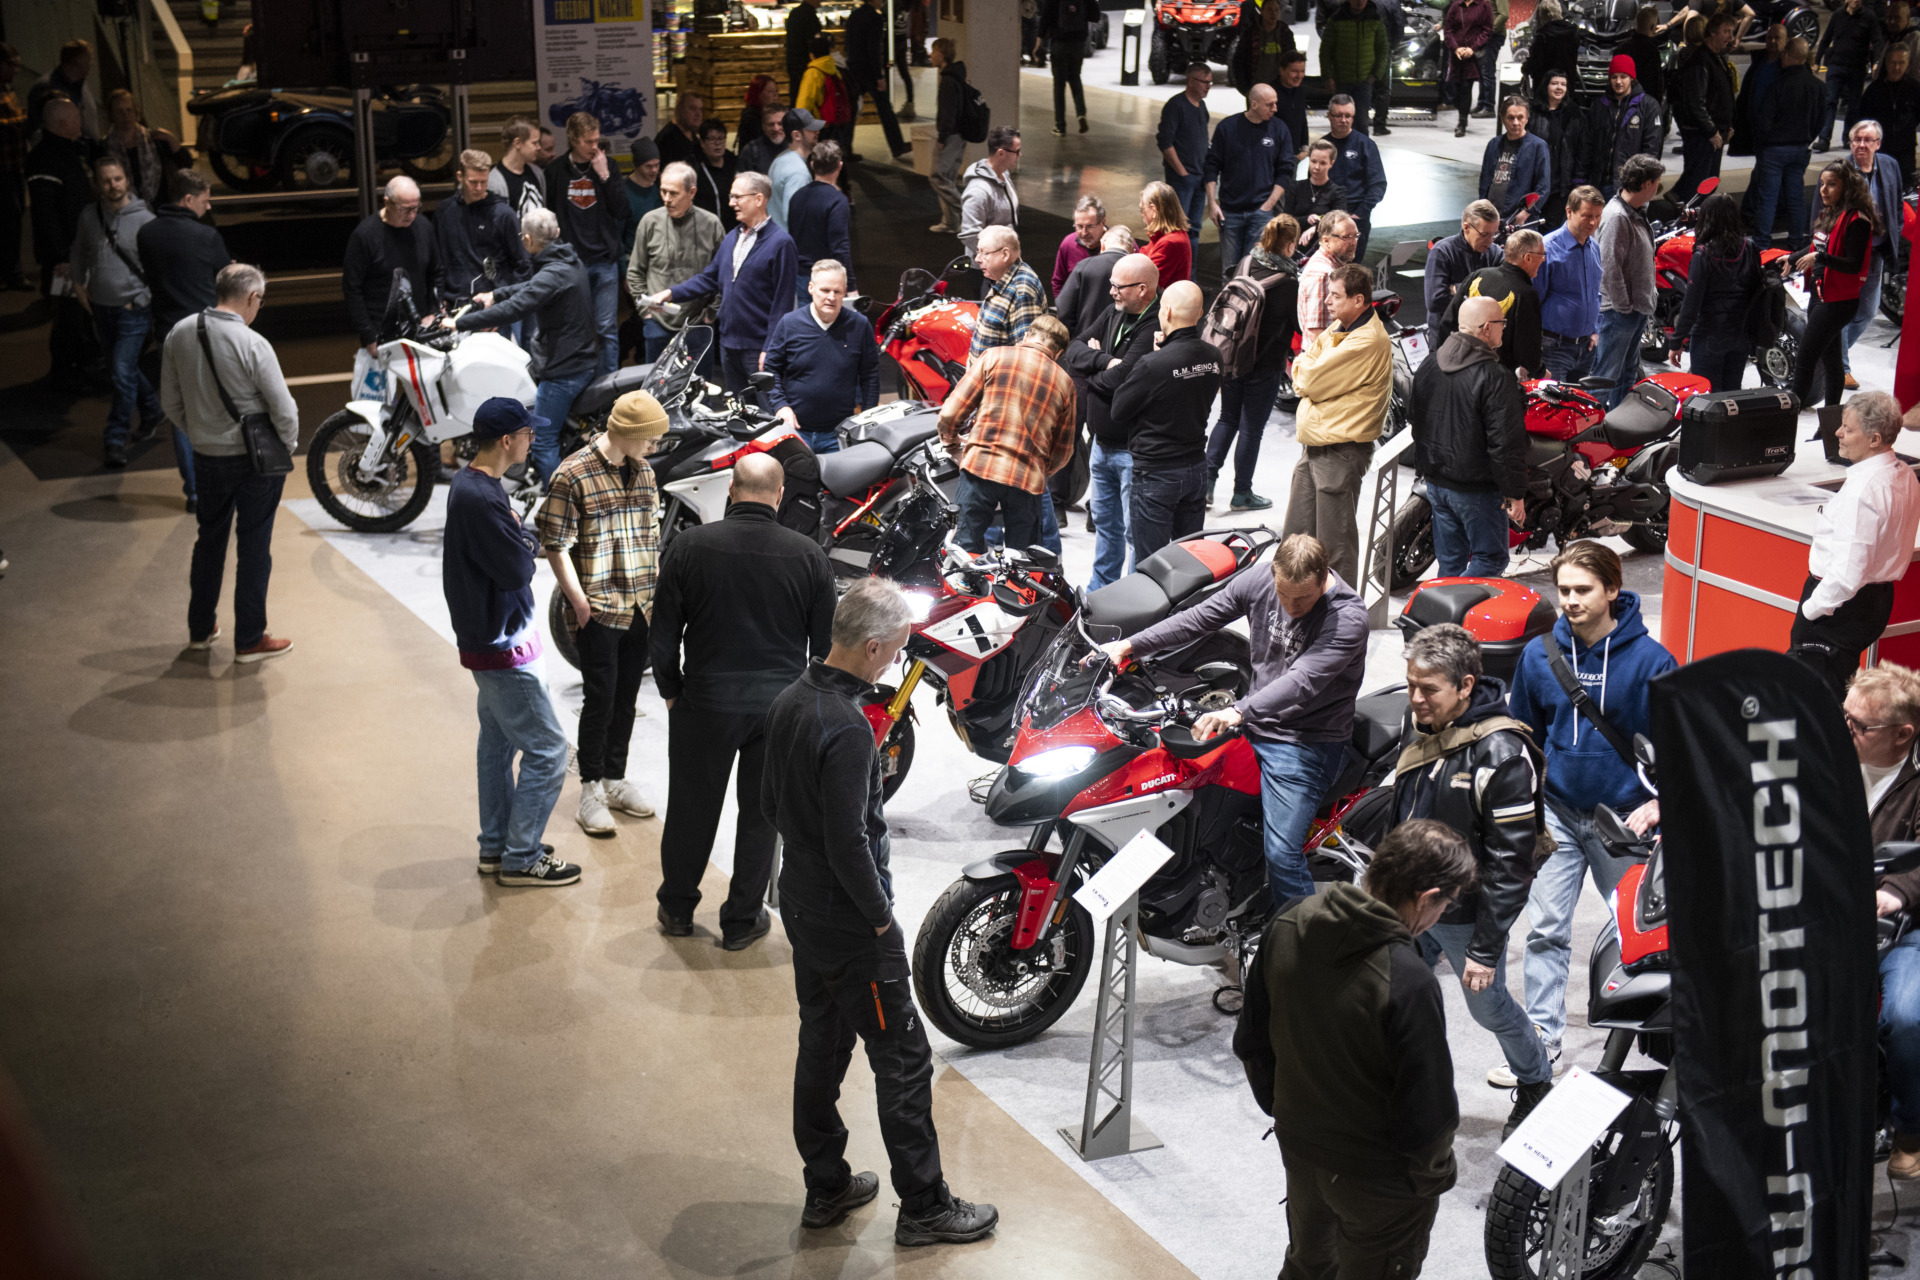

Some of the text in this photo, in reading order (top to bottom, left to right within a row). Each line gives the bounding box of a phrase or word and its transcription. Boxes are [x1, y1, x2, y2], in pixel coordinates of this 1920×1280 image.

[1191, 362, 1213, 373] HEINO
[1140, 772, 1177, 791] DUCATI
[1533, 1149, 1550, 1162] HEINO
